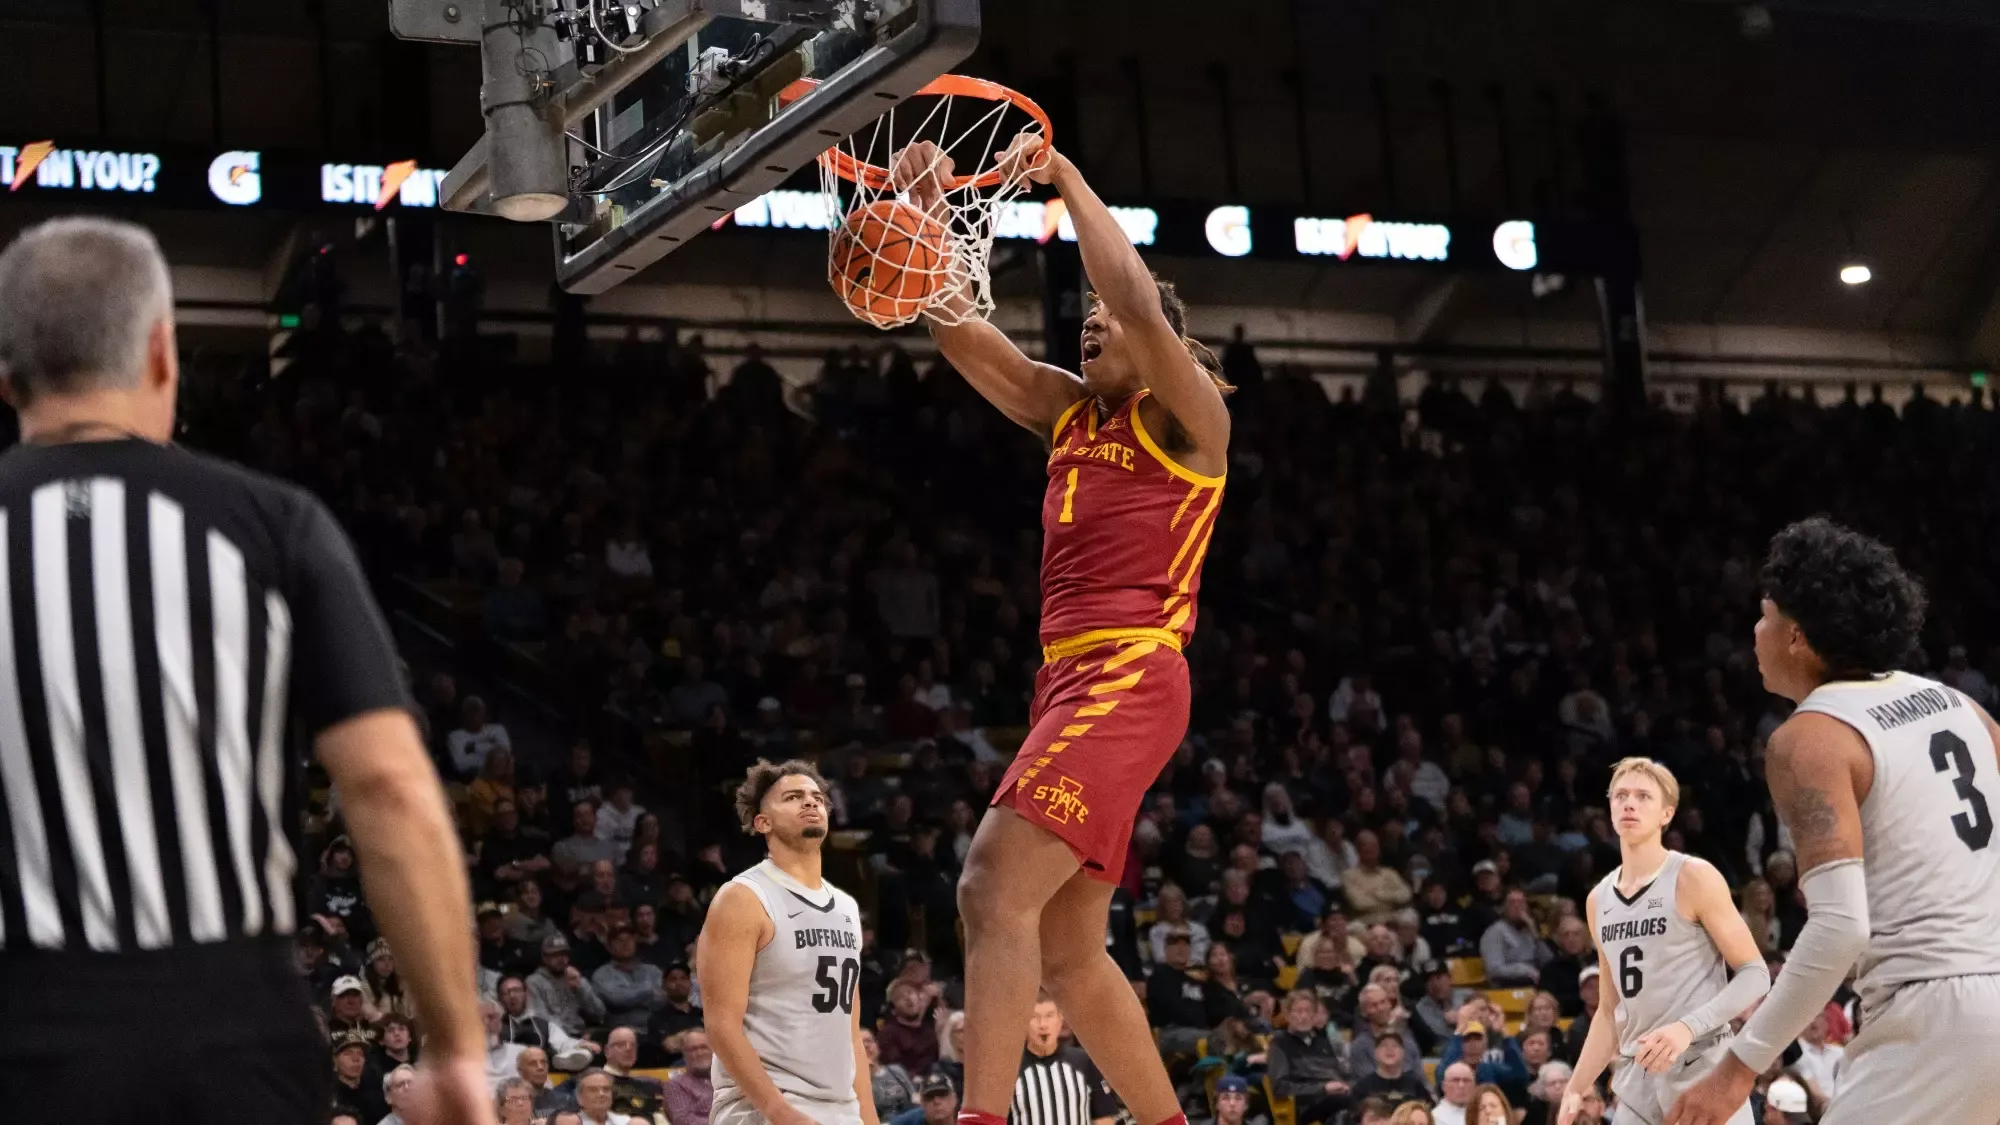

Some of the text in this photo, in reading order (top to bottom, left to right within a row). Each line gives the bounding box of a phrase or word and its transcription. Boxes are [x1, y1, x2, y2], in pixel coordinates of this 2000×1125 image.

[74, 151, 160, 192] YOU?
[208, 151, 261, 204] G
[322, 163, 353, 202] IS
[353, 165, 384, 204] IT
[1205, 205, 1252, 257] G
[1493, 220, 1538, 271] G
[1071, 442, 1135, 472] STATE
[1059, 467, 1079, 523] 1
[1866, 687, 1948, 731] HAMMOND
[1033, 785, 1089, 825] STATE
[1928, 729, 1994, 852] 3
[794, 928, 858, 950] BUFFALOE
[1601, 916, 1668, 944] BUFFALOES
[811, 955, 860, 1015] 50
[1619, 945, 1644, 999] 6
